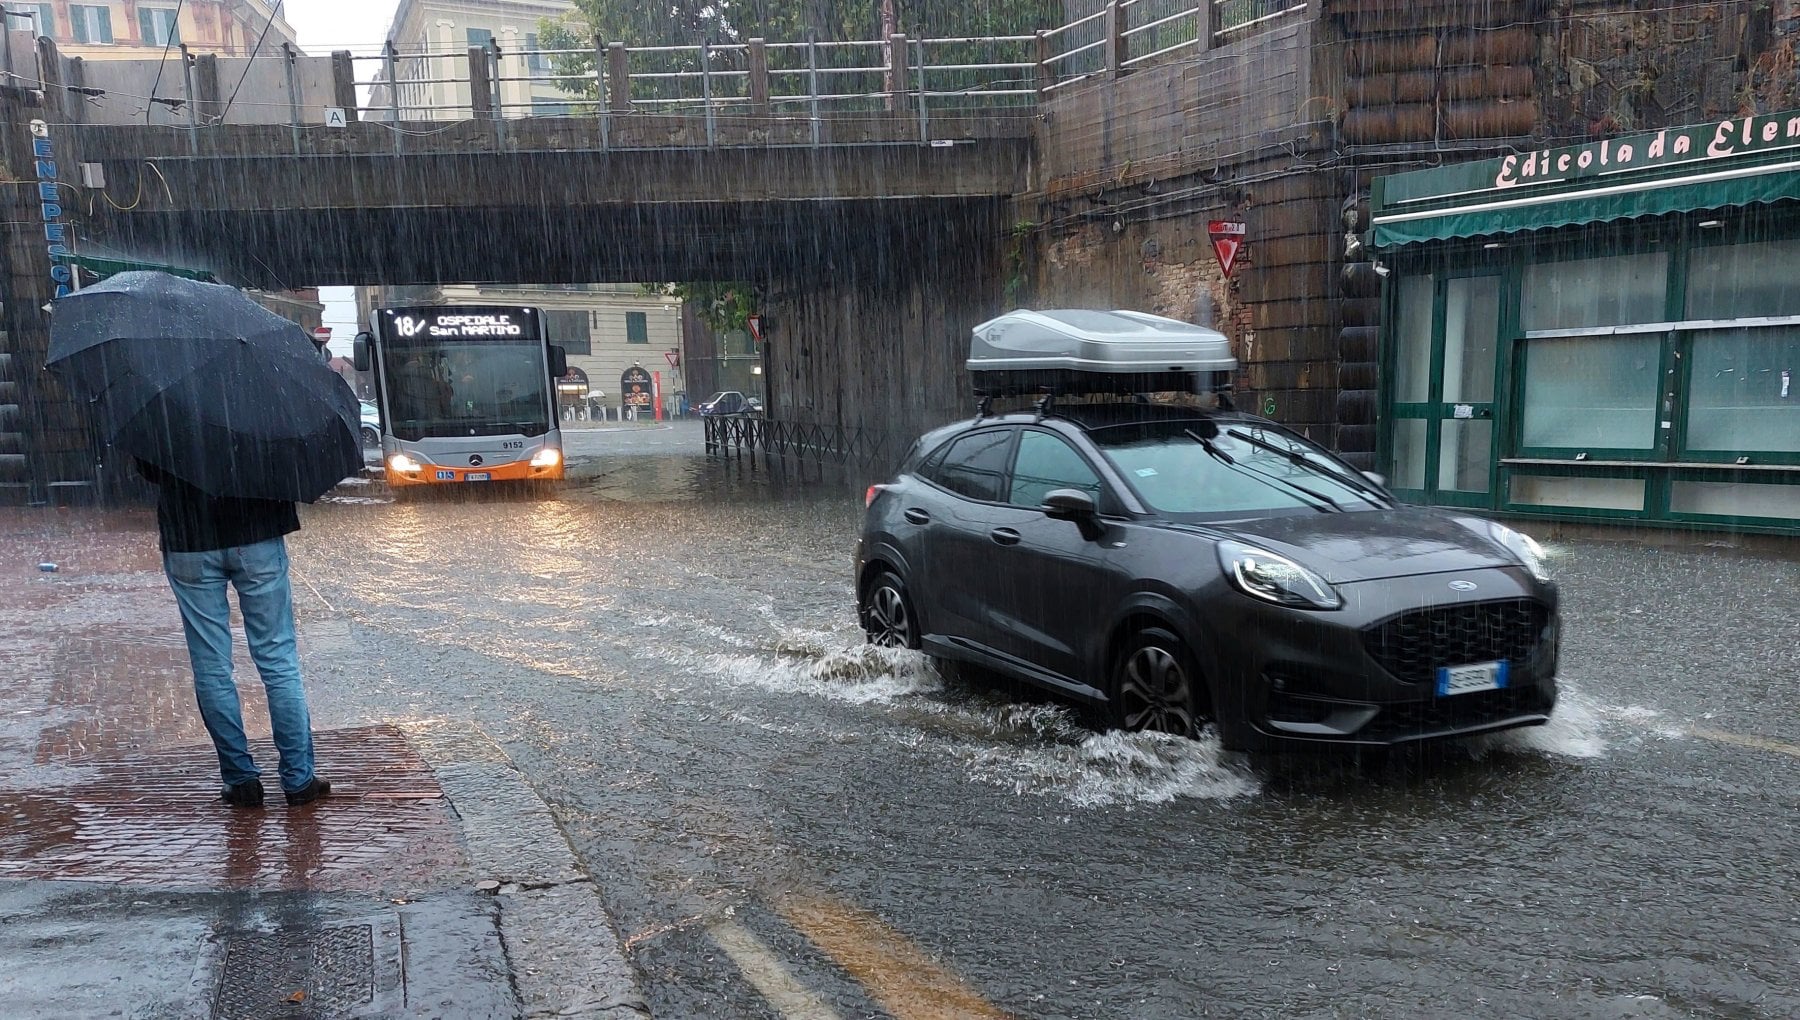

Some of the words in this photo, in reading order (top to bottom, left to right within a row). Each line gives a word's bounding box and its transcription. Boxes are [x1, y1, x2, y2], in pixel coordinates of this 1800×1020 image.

[330, 111, 342, 124] A
[1495, 139, 1633, 188] Edicola
[1648, 131, 1690, 158] da
[437, 315, 511, 326] OSPEDALE
[429, 325, 459, 336] San
[461, 324, 521, 336] MARTINO
[502, 441, 524, 449] 9152
